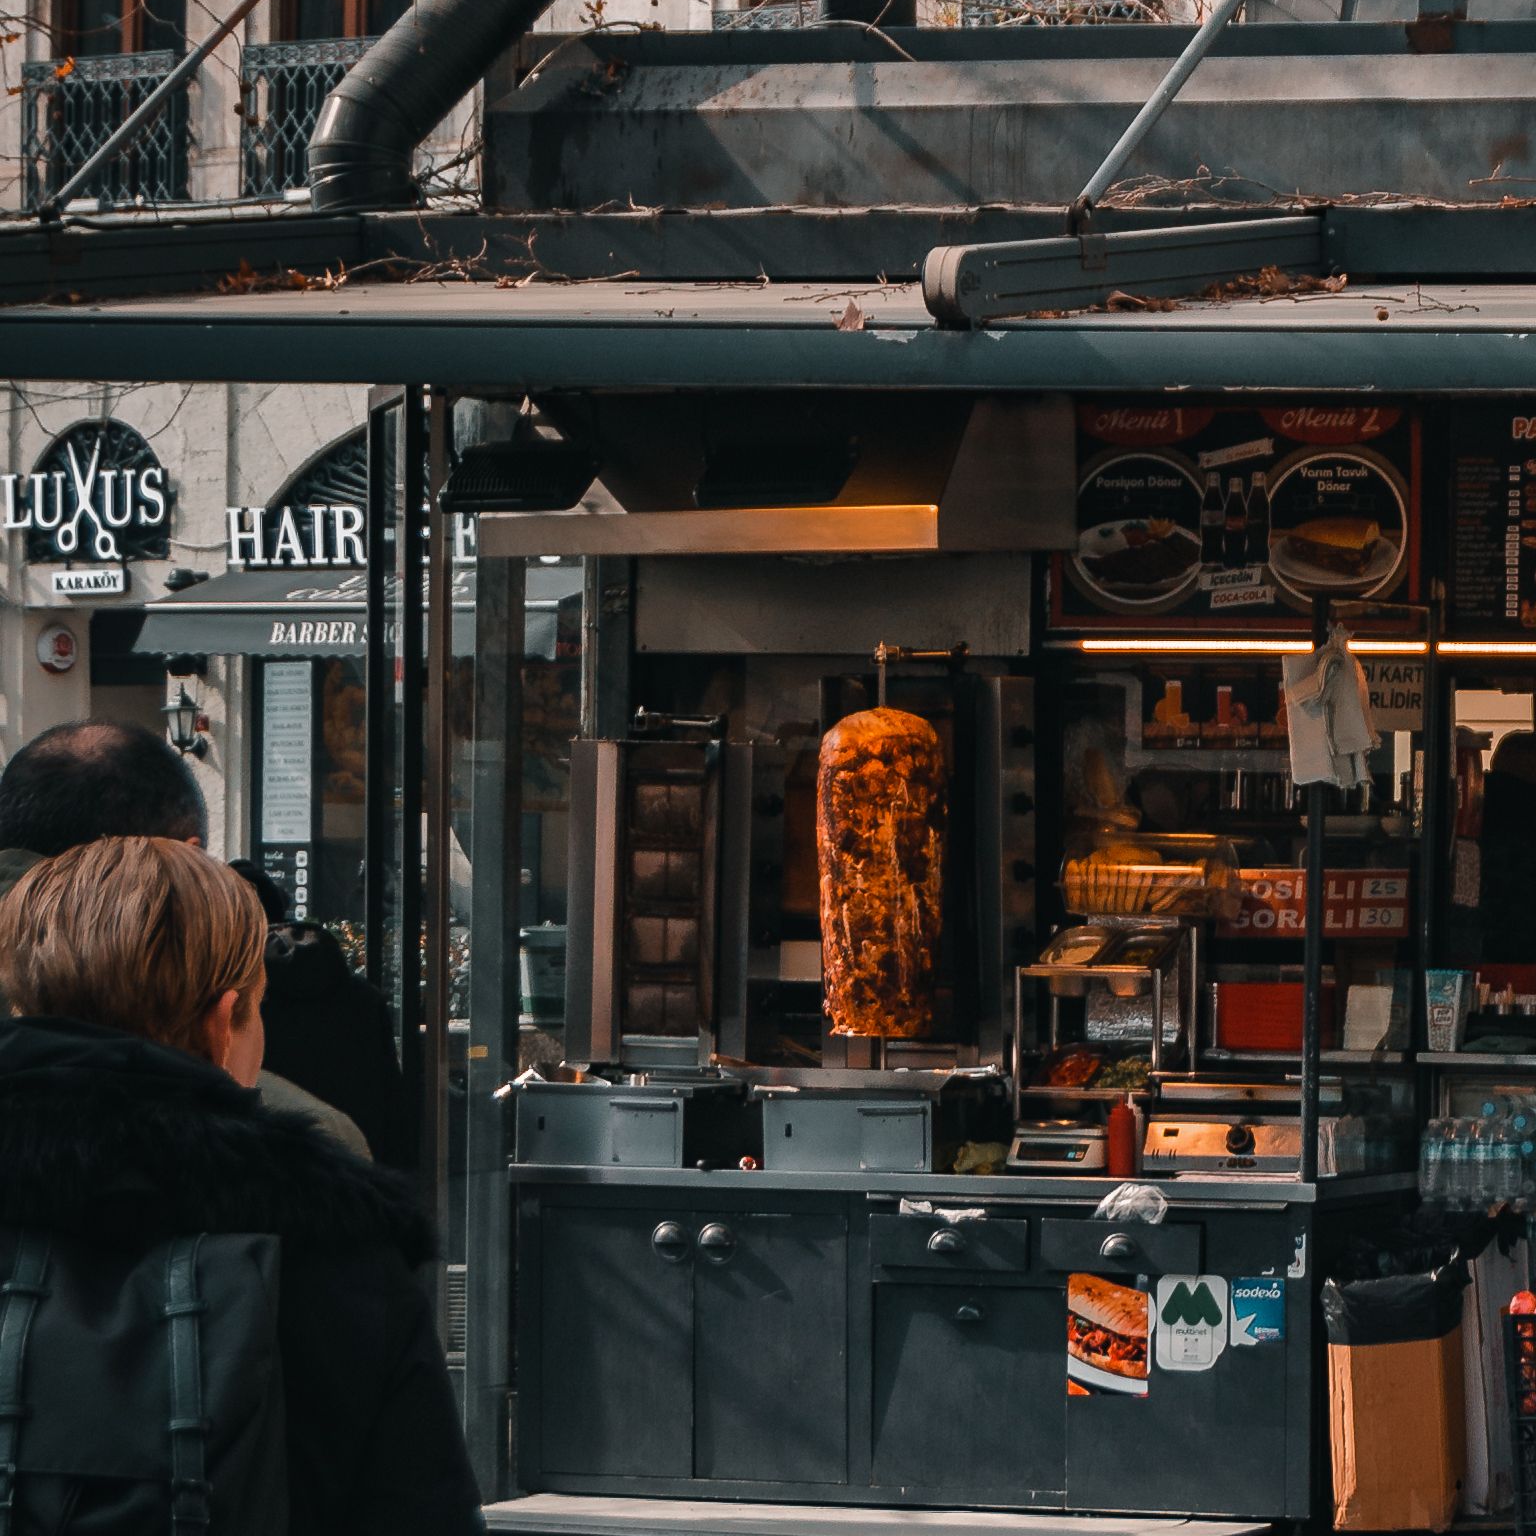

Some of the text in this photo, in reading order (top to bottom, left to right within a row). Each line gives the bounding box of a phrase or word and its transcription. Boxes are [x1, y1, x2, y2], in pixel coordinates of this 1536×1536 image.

[1336, 465, 1369, 479] Tavuk
[1095, 474, 1183, 490] Porsiyon Döner
[1317, 479, 1352, 493] Döner
[0, 446, 164, 554] LUXUS
[226, 503, 368, 565] HAIR
[55, 572, 121, 591] KARAKÖY
[1212, 588, 1269, 604] COCA-COLA
[269, 621, 356, 644] BARBER
[1379, 665, 1424, 683] KART
[1369, 880, 1398, 896] 25
[1366, 909, 1393, 926] 30
[1234, 1281, 1282, 1300] sodexo
